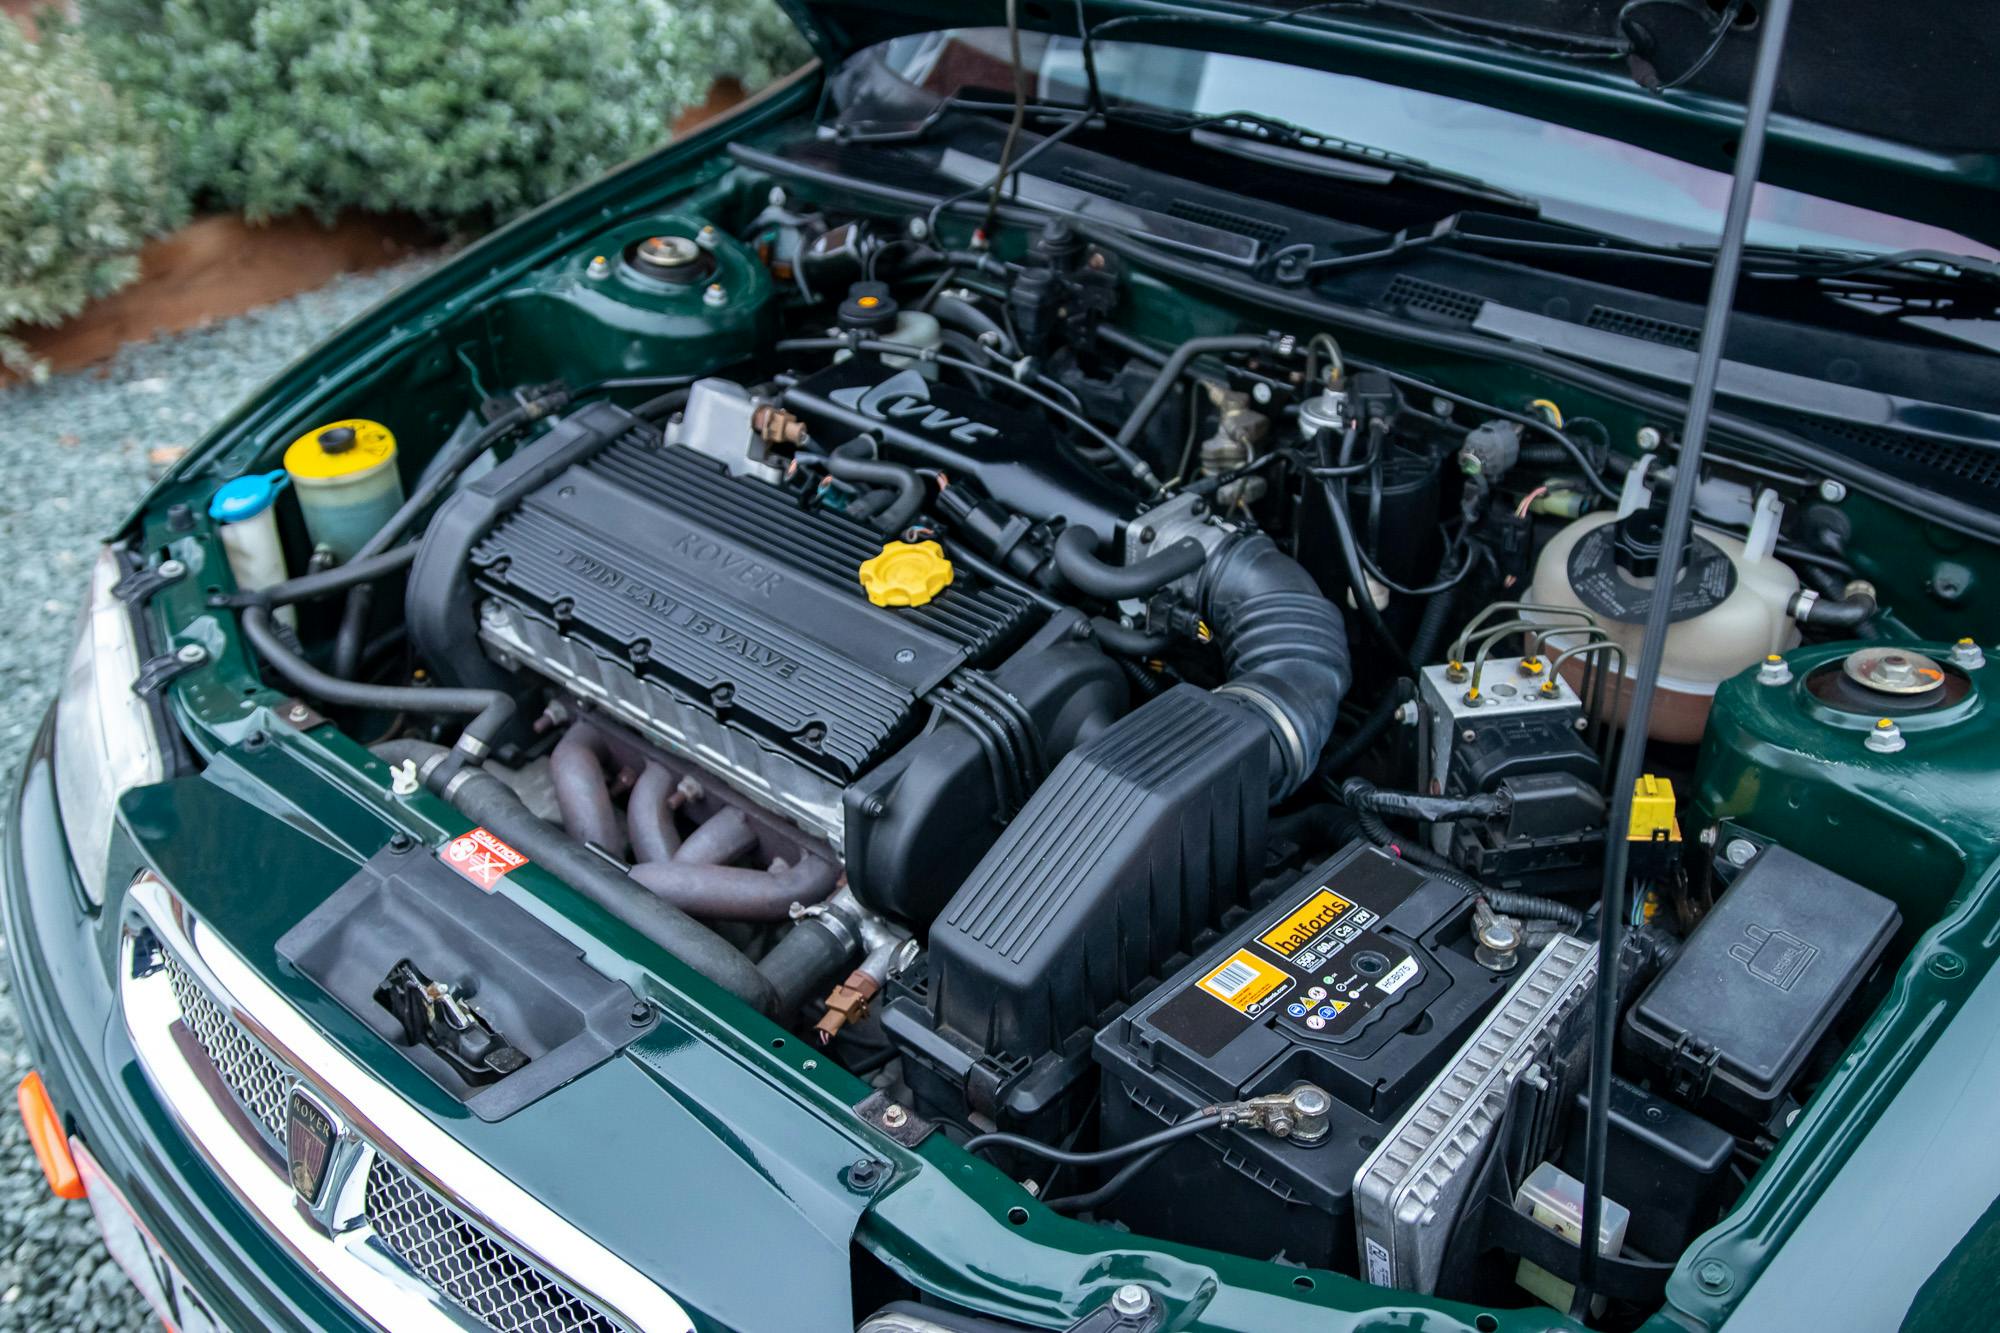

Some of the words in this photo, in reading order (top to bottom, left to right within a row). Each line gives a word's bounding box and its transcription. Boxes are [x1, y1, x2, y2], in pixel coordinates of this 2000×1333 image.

[888, 396, 999, 443] VVC
[672, 532, 785, 598] ROVER
[566, 554, 624, 589] TWIN
[624, 583, 679, 617] CAM
[683, 614, 716, 635] 16
[717, 627, 799, 680] VALVE
[474, 829, 524, 865] CAUTION
[1274, 900, 1347, 952] halfords
[1335, 925, 1353, 937] Ca
[1352, 910, 1371, 924] 12V
[293, 1096, 330, 1138] ROVER
